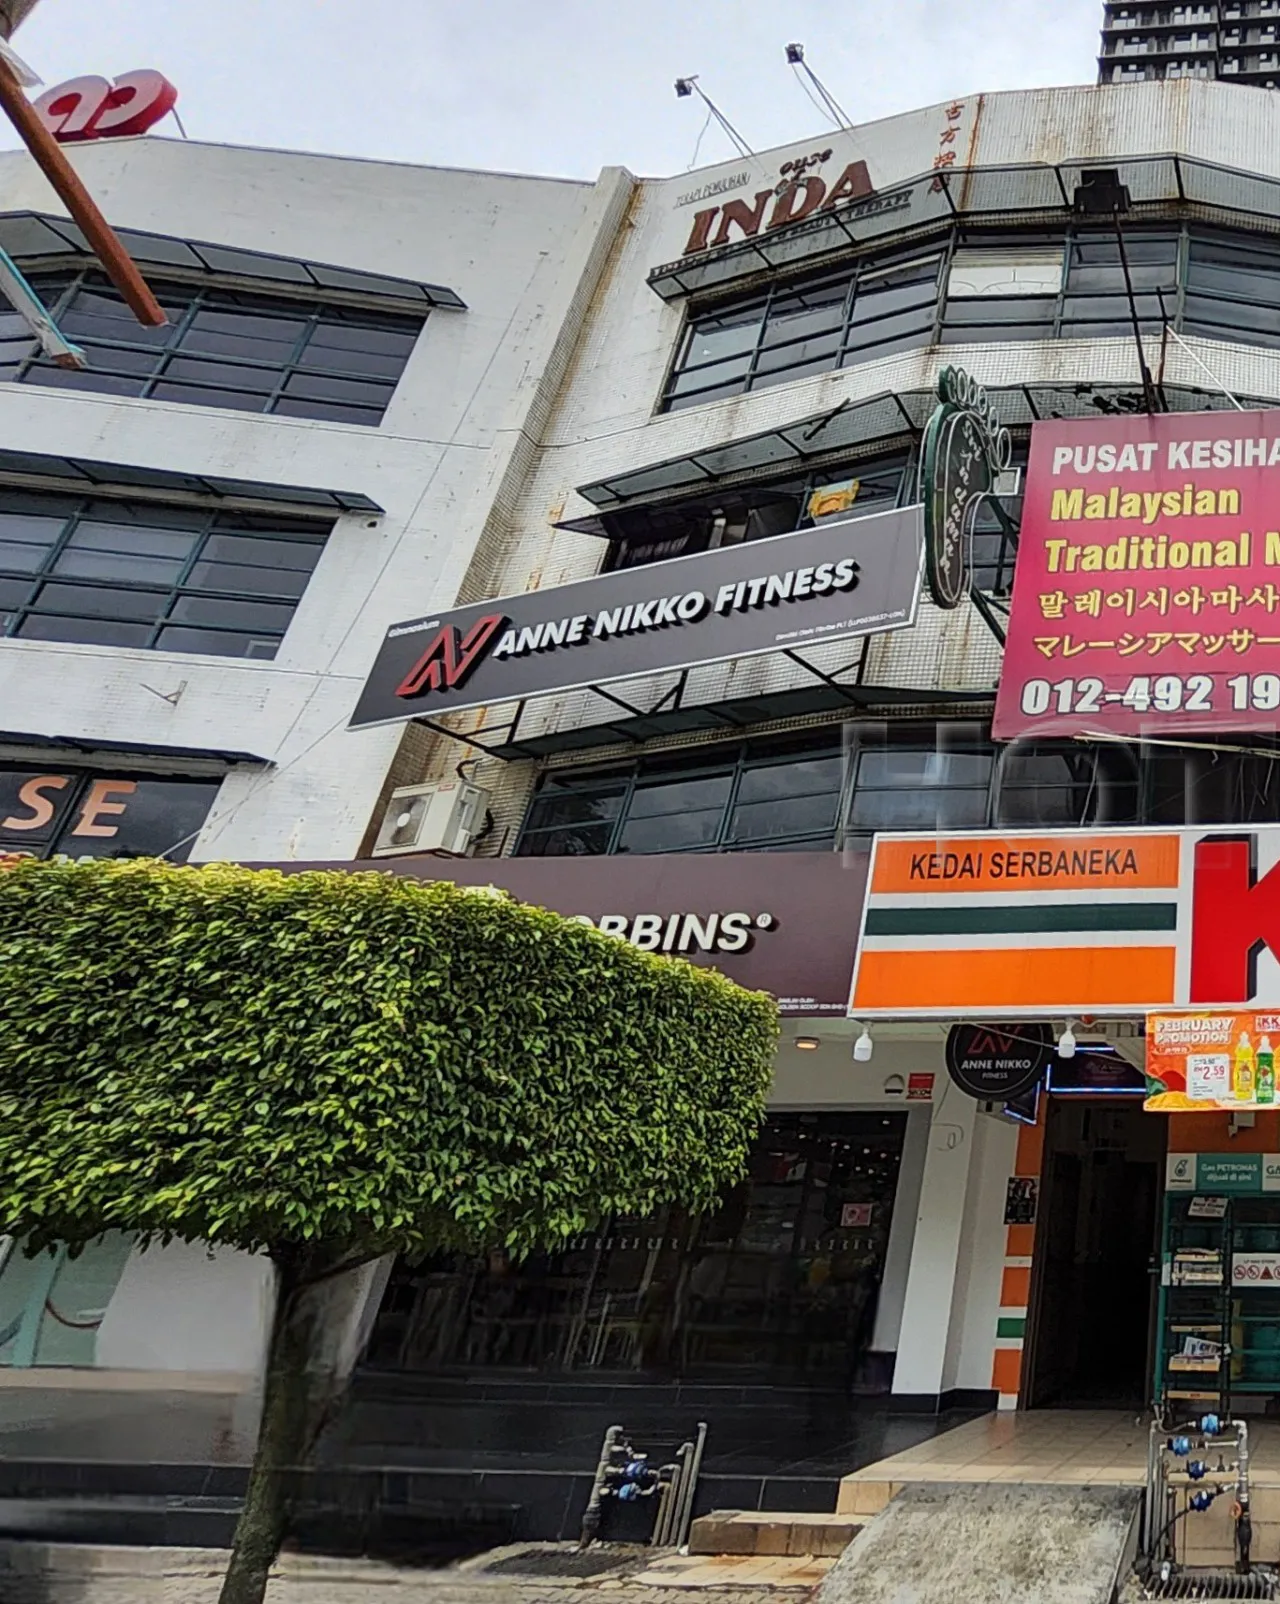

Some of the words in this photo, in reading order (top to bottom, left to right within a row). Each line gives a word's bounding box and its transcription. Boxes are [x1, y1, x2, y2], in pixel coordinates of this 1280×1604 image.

[682, 159, 877, 256] INDA
[1052, 442, 1158, 475] PUSAT
[1050, 484, 1240, 526] Malaysian
[1044, 532, 1251, 573] Traditional
[492, 614, 589, 658] ANNE
[594, 591, 706, 640] NIKKO
[713, 558, 859, 613] FITNESS
[1020, 673, 1214, 716] 012-492
[910, 850, 983, 880] KEDAI
[989, 848, 1139, 879] SERBANEKA
[568, 912, 752, 952] BBINS
[1156, 1032, 1230, 1044] PROMOTION
[1157, 1018, 1233, 1032] FEBRUARY
[961, 1059, 993, 1070] ANNE
[995, 1058, 1031, 1070] NIKKO
[982, 1071, 1008, 1080] FITNESS
[1217, 1164, 1258, 1172] PETRONAS
